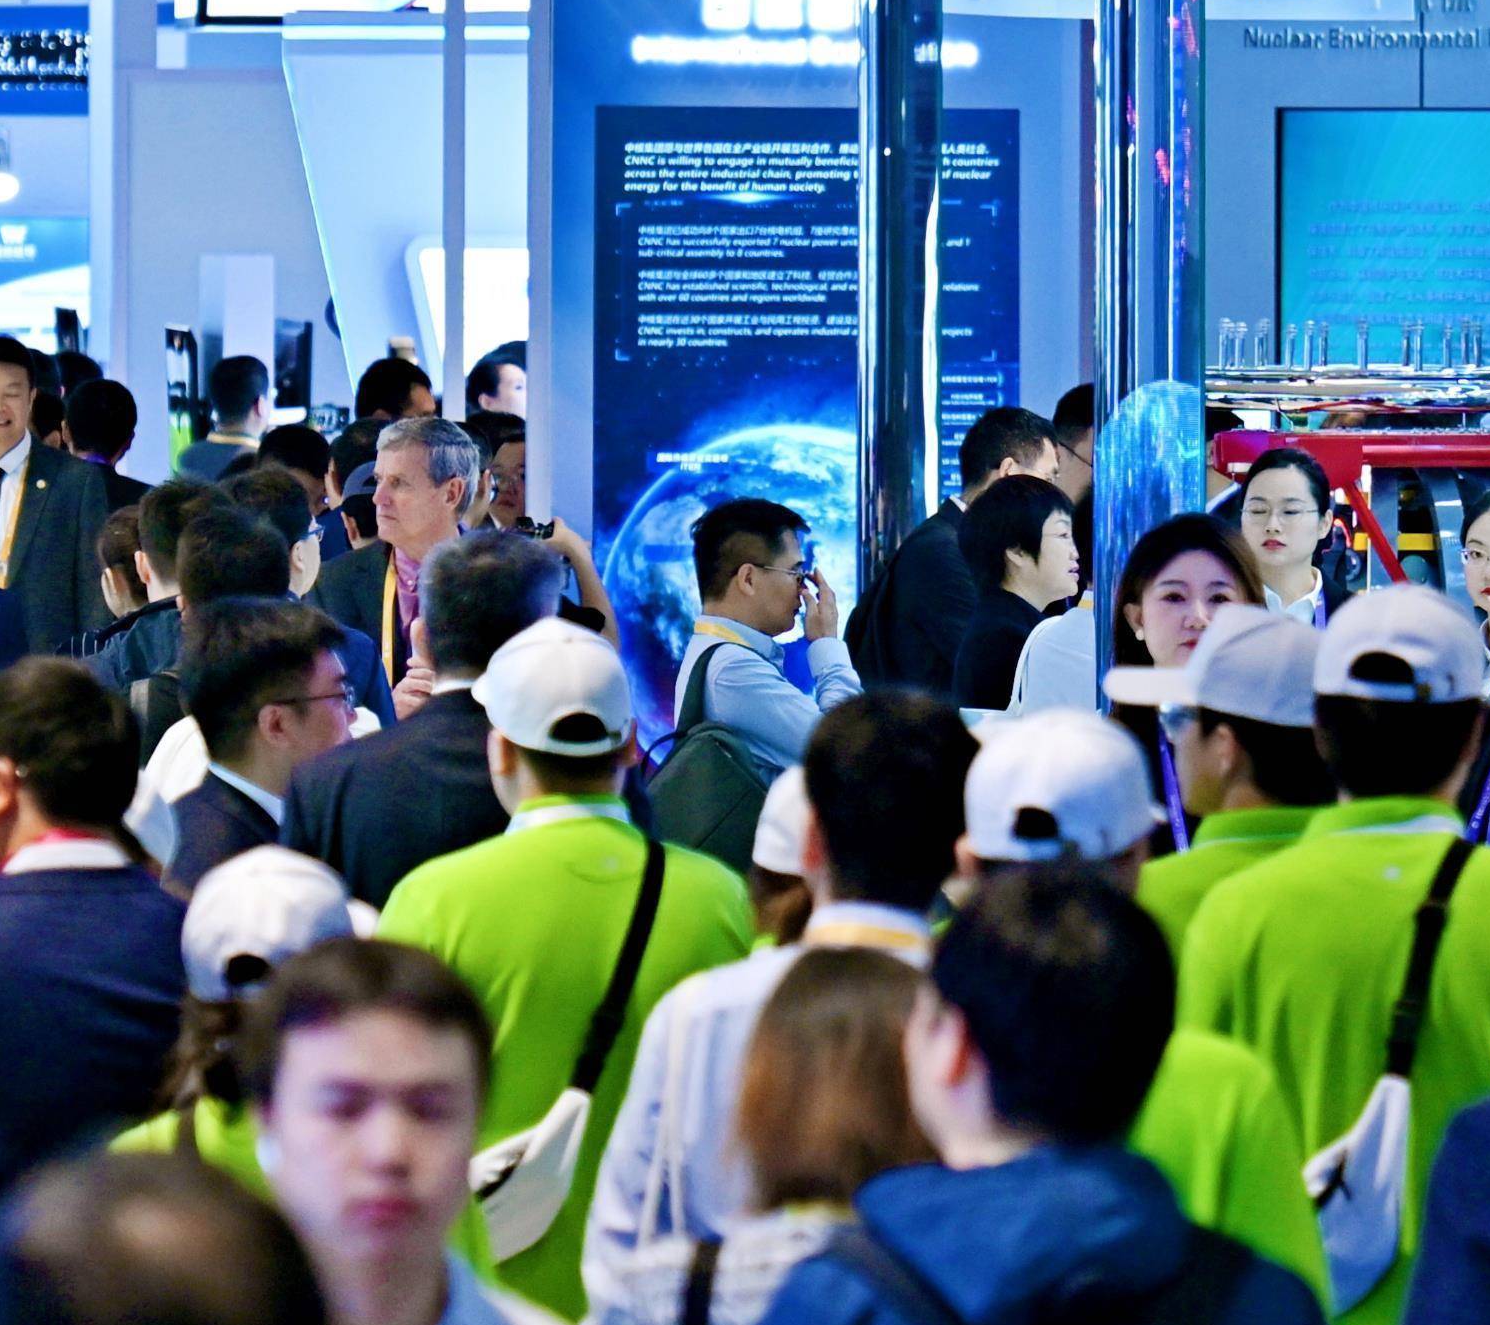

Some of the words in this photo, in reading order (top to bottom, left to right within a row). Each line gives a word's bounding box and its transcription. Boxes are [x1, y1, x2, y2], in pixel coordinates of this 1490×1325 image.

[1329, 27, 1480, 49] Environmental
[624, 156, 656, 166] CNNC
[657, 156, 667, 166] is
[668, 156, 702, 168] willing
[704, 157, 716, 166] to
[716, 158, 754, 169] engage
[756, 157, 767, 166] in
[768, 157, 813, 168] mutually
[951, 158, 1000, 167] countries
[624, 170, 657, 178] across
[658, 168, 676, 178] the
[678, 169, 709, 178] entire
[710, 169, 760, 178] industrial
[795, 169, 851, 181] promoting
[952, 169, 992, 179] nuclear
[624, 183, 660, 194] energy
[662, 181, 679, 191] for
[680, 181, 698, 191] the
[700, 181, 737, 191] benefit
[738, 181, 751, 191] of
[751, 182, 787, 192] human
[637, 237, 664, 246] CNNC
[637, 281, 664, 291] CNNC
[637, 326, 664, 336] CNNC
